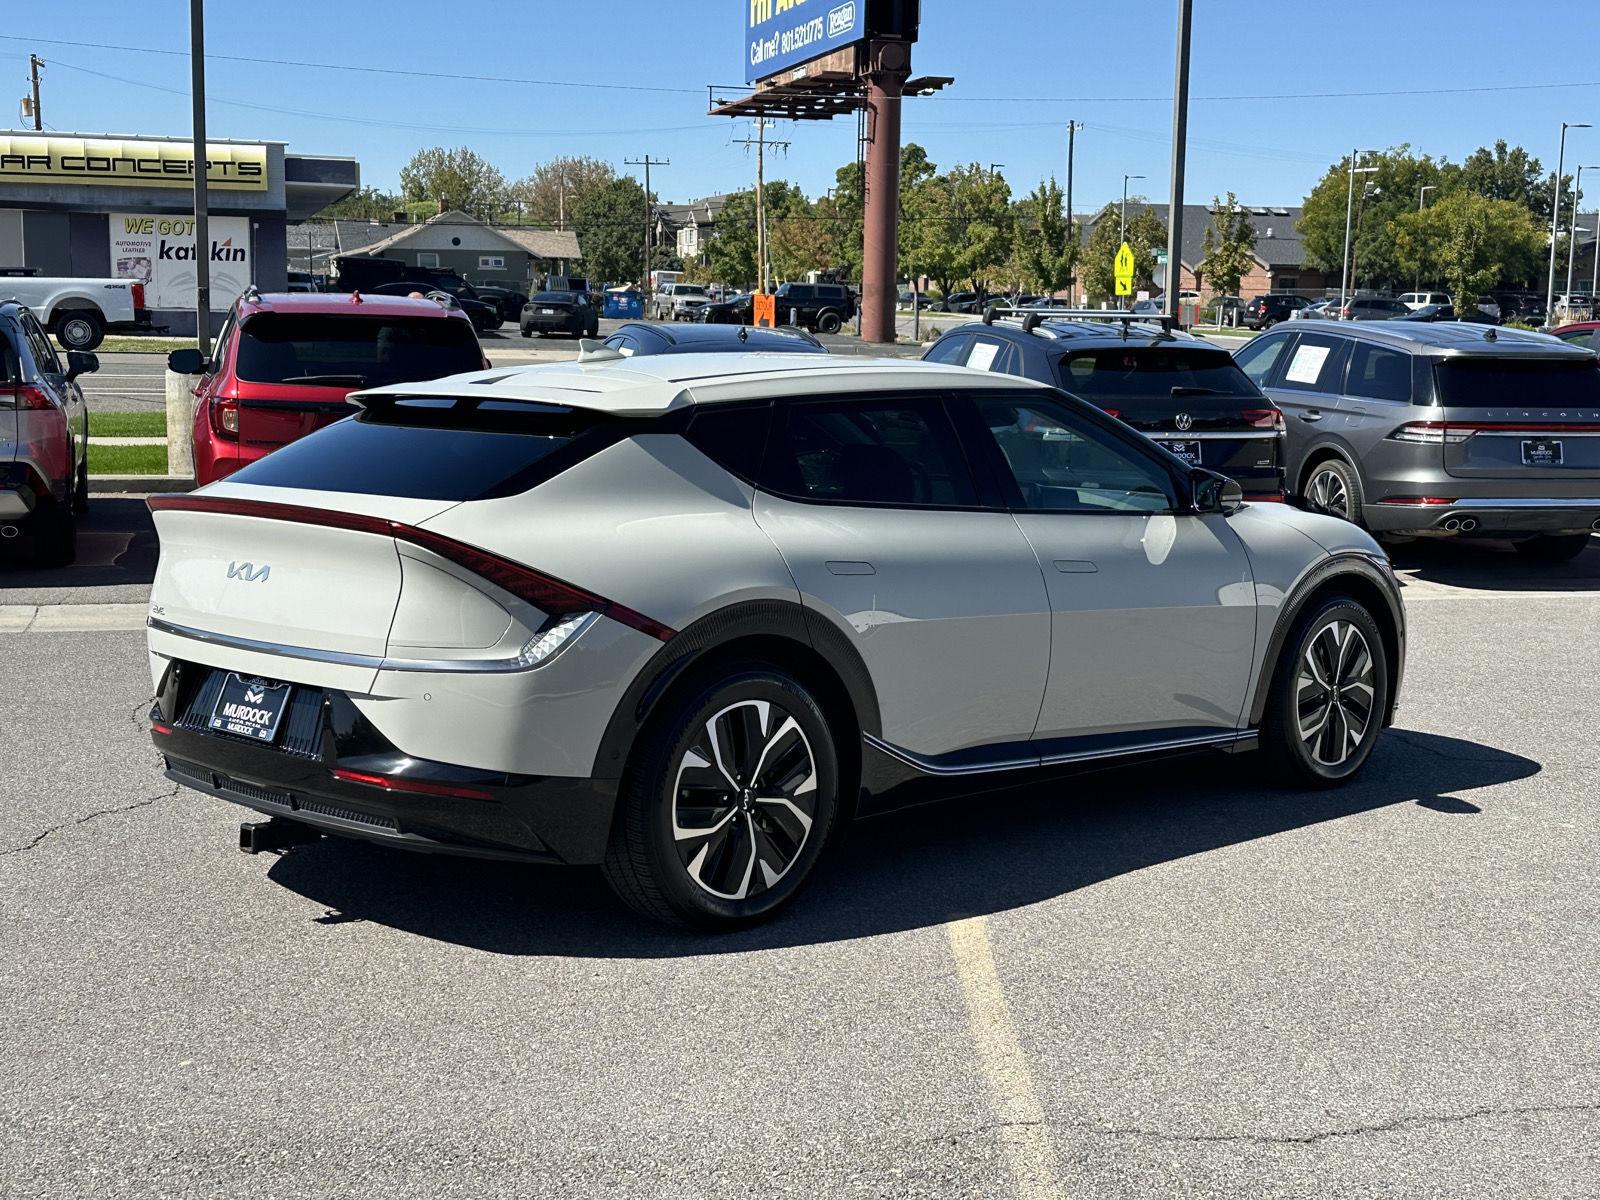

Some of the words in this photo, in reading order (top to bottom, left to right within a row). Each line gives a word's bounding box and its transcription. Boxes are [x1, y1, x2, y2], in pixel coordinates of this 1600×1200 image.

[750, 38, 764, 66] Call
[764, 30, 779, 60] me?
[61, 156, 262, 176] CONCEPTS
[124, 216, 155, 234] WE
[157, 219, 195, 236] GOT
[158, 238, 246, 261] katkin
[222, 702, 273, 726] MURDOCK
[226, 722, 254, 735] MURDOCK
